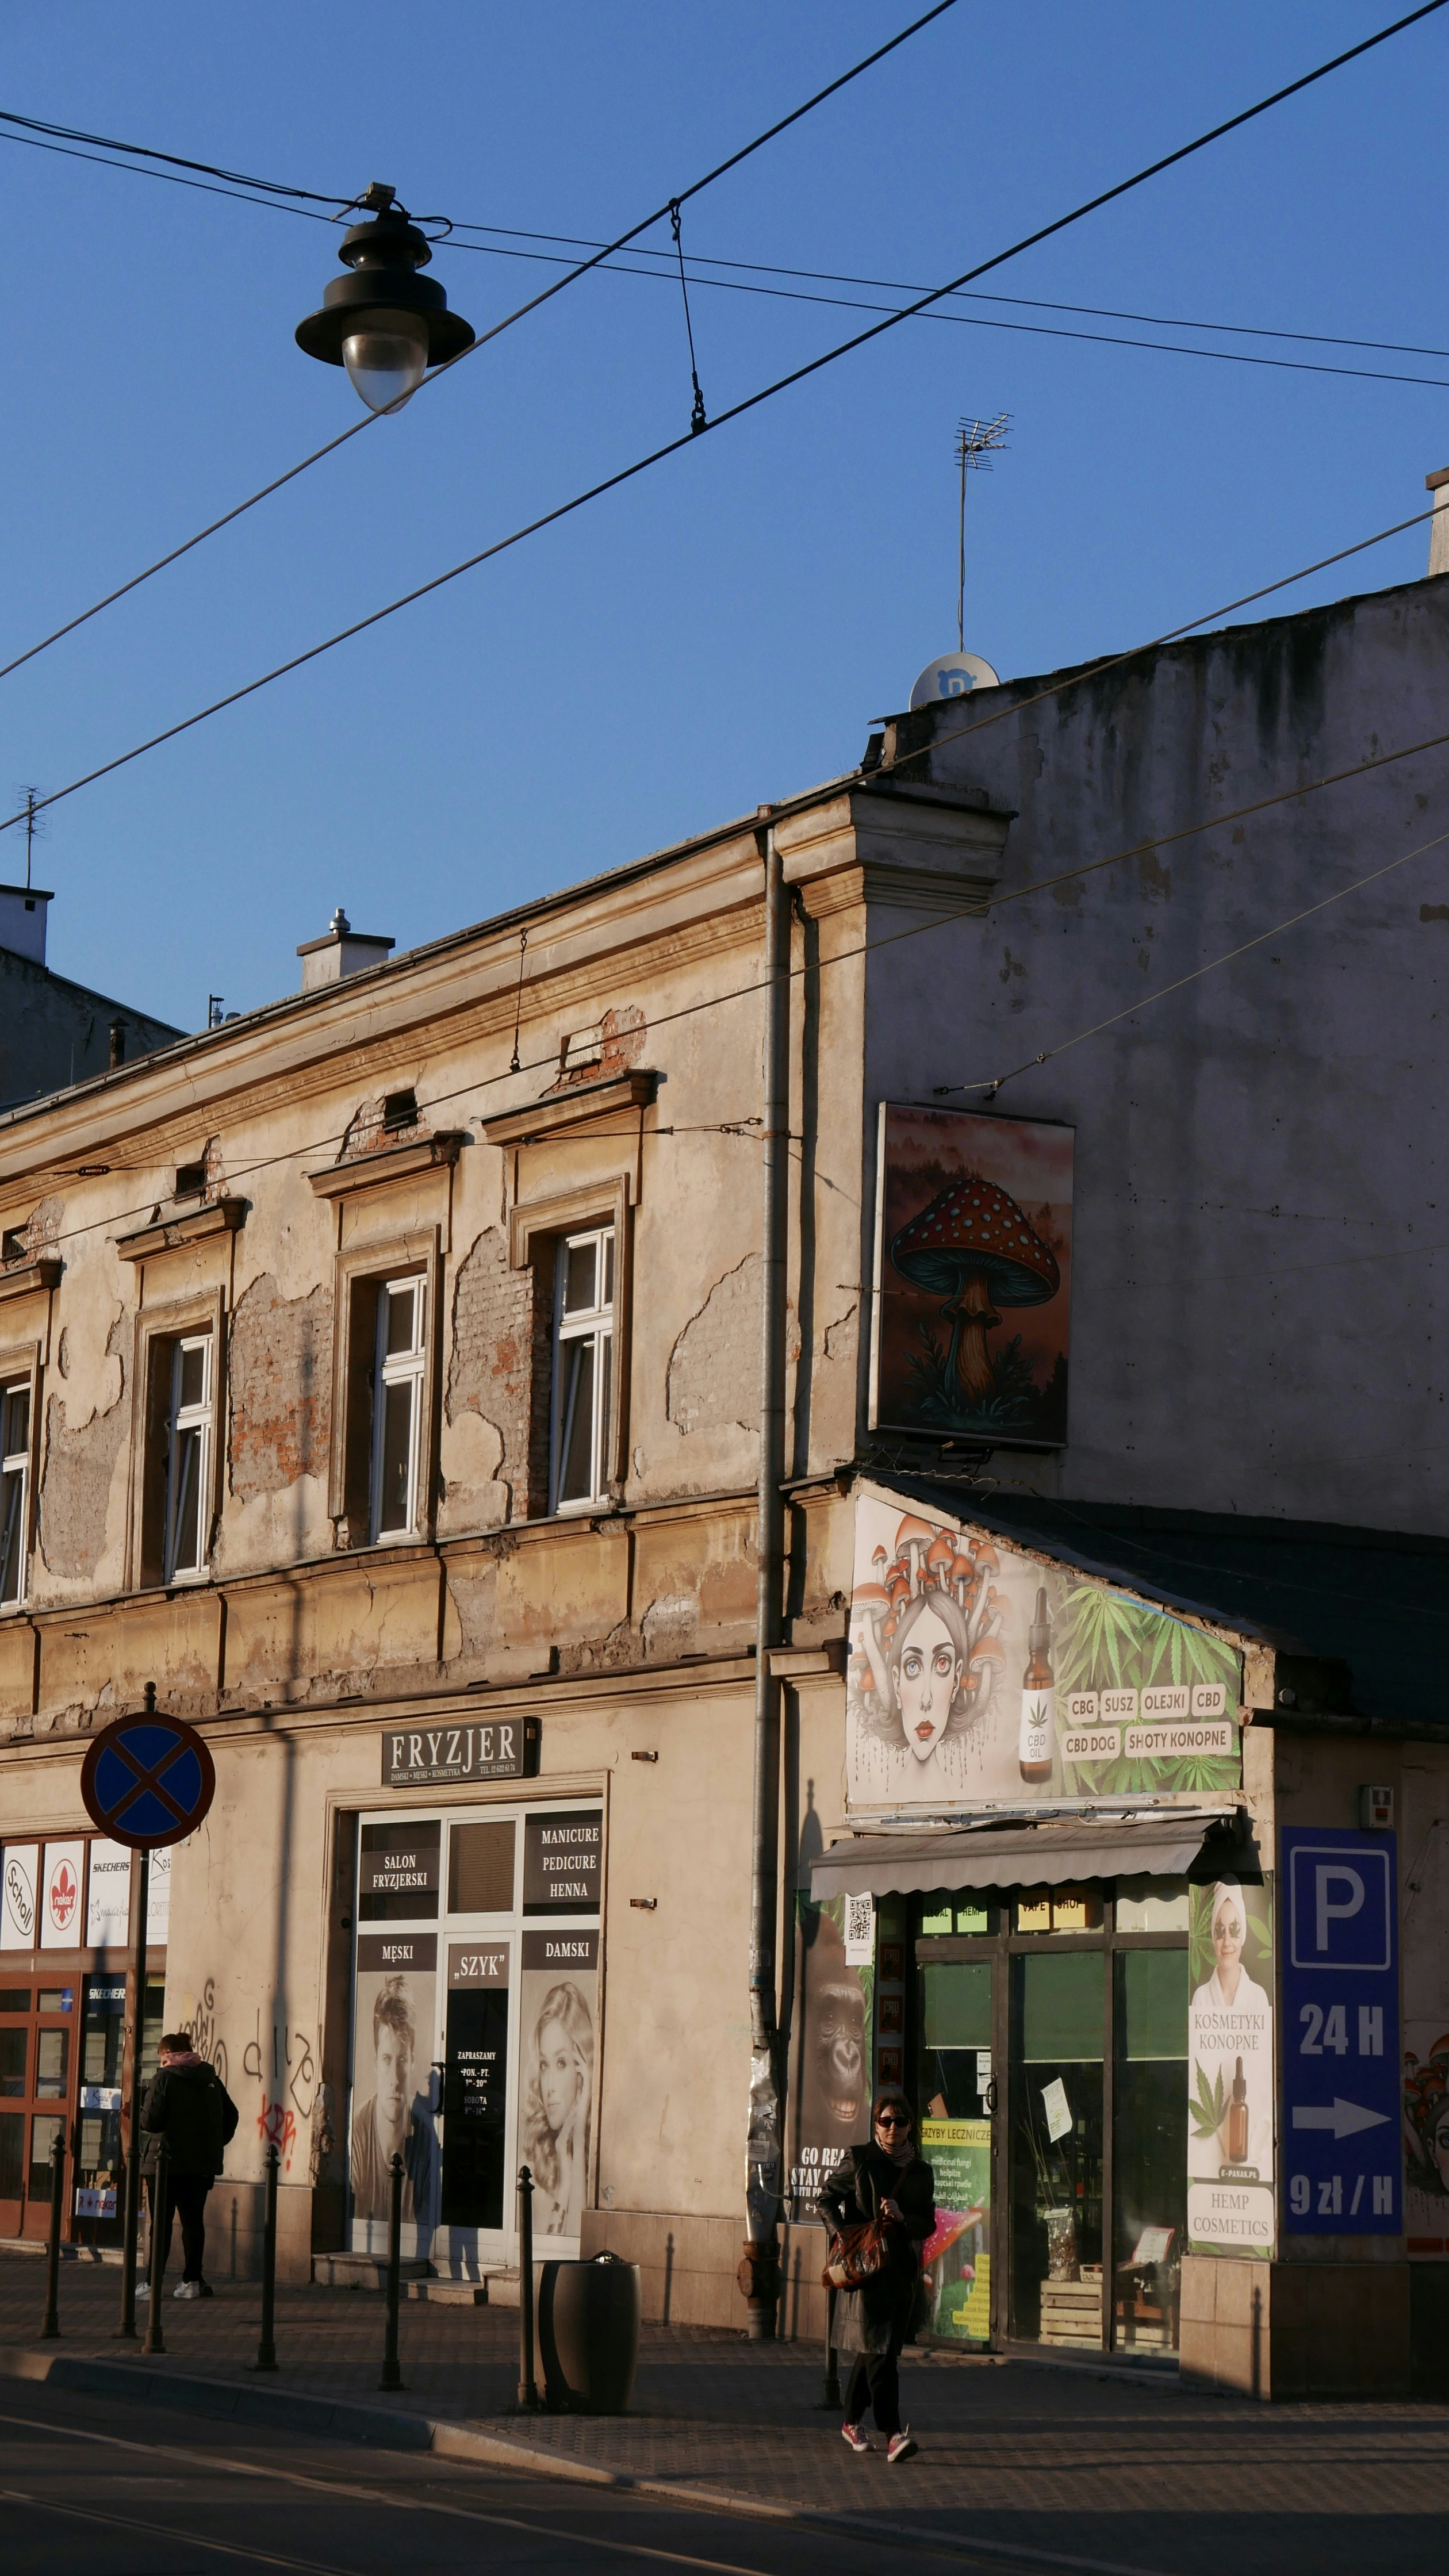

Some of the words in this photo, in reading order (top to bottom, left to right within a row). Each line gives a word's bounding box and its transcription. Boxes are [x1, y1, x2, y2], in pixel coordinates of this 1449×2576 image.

[1072, 1700, 1094, 1716] CBG
[1105, 1696, 1133, 1713] SUSZ
[1144, 1693, 1185, 1711] OLEJKI
[1197, 1692, 1220, 1708] CBD
[1028, 1734, 1046, 1747] CBD
[1066, 1738, 1088, 1753] CBD
[1091, 1735, 1116, 1751] DOG
[1129, 1732, 1168, 1750] SHOTY
[1170, 1730, 1226, 1747] KONOPNE
[391, 1726, 516, 1773] FRYZJER
[1030, 1749, 1042, 1758] OIL
[391, 1772, 409, 1781] DAMSKI
[413, 1770, 428, 1781] MĘSKI
[432, 1768, 461, 1778] KOSMETYKA
[480, 1766, 490, 1774] TEL.
[542, 1828, 599, 1845] MANICURE
[93, 1862, 131, 1873] SKECHERS
[151, 1849, 171, 1874] Kos
[385, 1855, 416, 1869] SALON
[543, 1855, 596, 1870] PEDICURE
[373, 1872, 427, 1890] FRYZJERSKI
[8, 1866, 33, 1929] Scholl
[550, 1883, 588, 1897] HENNA
[927, 1908, 948, 1918] LEGAL
[963, 1907, 982, 1916] HEMP
[1022, 1901, 1045, 1912] VAPE
[1057, 1898, 1082, 1910] SHOP
[1316, 1865, 1365, 1951] P
[382, 1945, 413, 1962] MĘSKI
[546, 1942, 589, 1957] DAMSKI
[89, 1988, 126, 1999] SKECHER
[1194, 2014, 1265, 2030] KOSMETYKI
[1300, 2003, 1349, 2056] 24
[1359, 2006, 1383, 2056] H
[1199, 2034, 1259, 2050] KONOPNE
[458, 2052, 496, 2060] ZAPRASZAMY
[464, 2096, 488, 2104] SOBOTA
[922, 2128, 945, 2139] GRZYBY
[948, 2128, 991, 2141] LECZNICZE
[802, 2146, 819, 2165] GO
[931, 2157, 956, 2166] medicinal
[957, 2158, 971, 2168] fungi
[791, 2167, 822, 2186] STAY
[1221, 2169, 1258, 2179] E-PANAS.PL
[934, 2179, 954, 2188] карські
[793, 2186, 811, 2197] WITH
[1290, 2174, 1310, 2215] 9
[1317, 2175, 1343, 2214] zł
[1373, 2176, 1393, 2214] H
[1211, 2193, 1249, 2210] HEMP
[1194, 2217, 1268, 2236] COSMETICS
